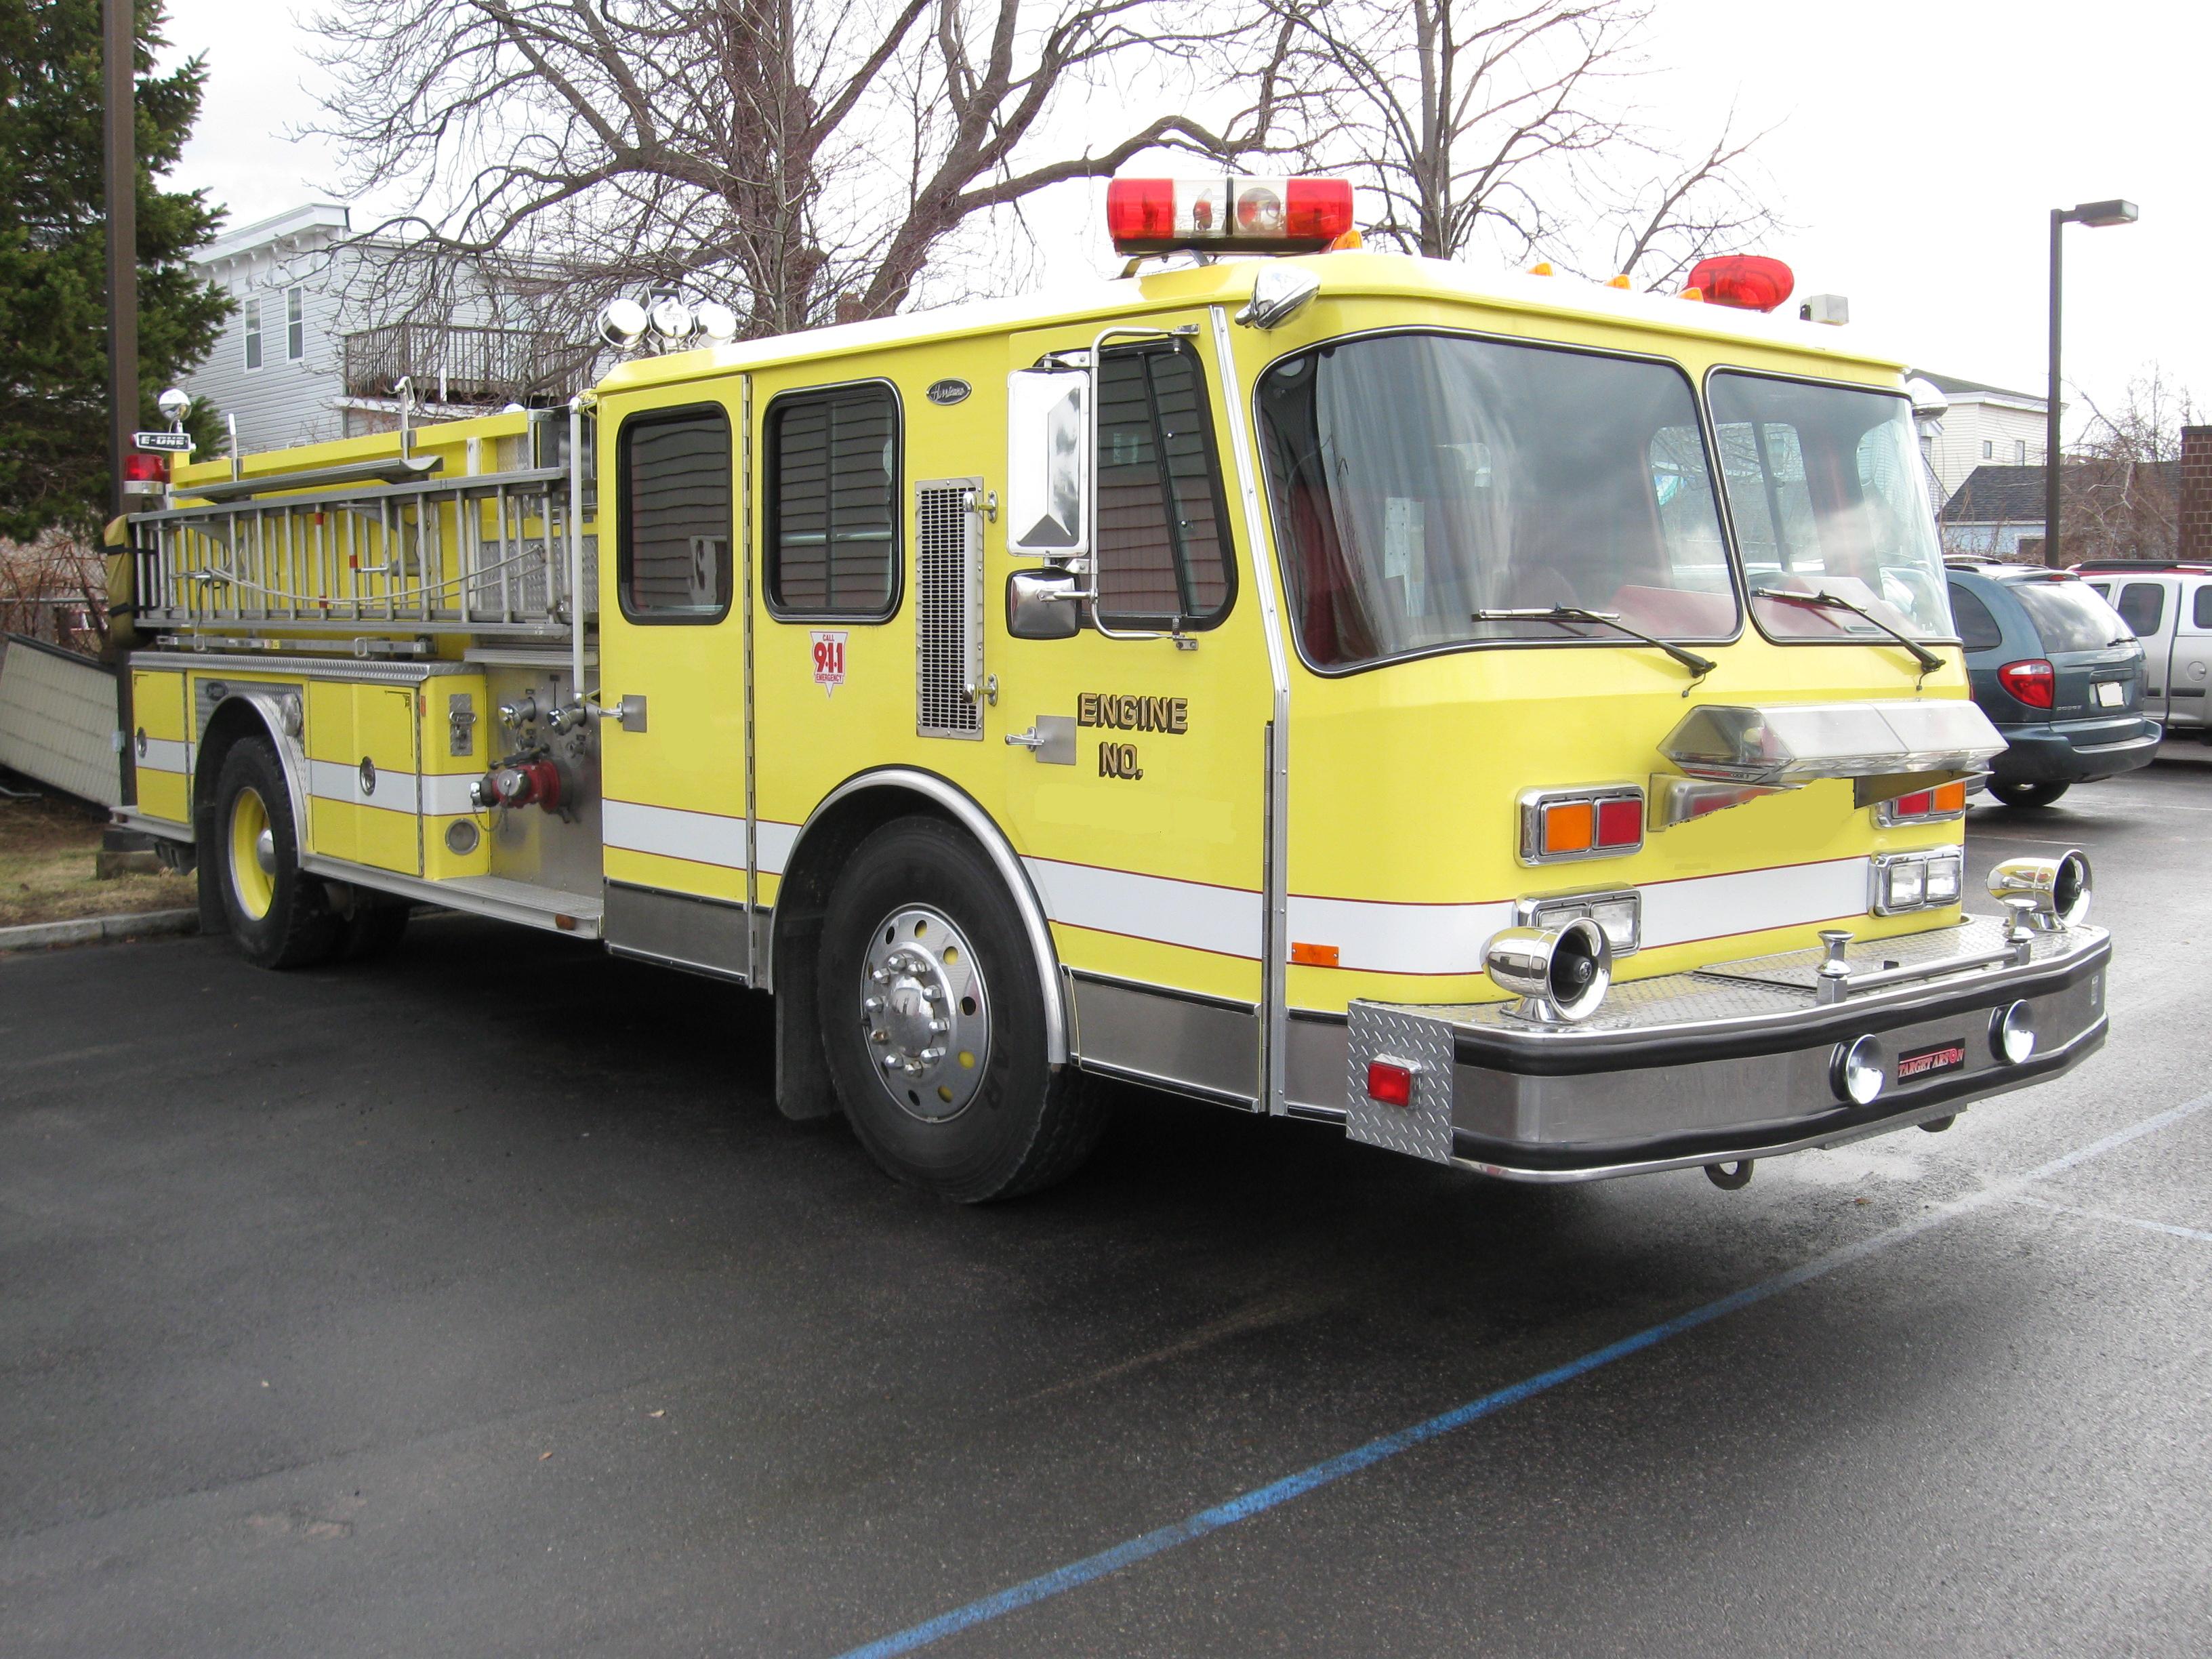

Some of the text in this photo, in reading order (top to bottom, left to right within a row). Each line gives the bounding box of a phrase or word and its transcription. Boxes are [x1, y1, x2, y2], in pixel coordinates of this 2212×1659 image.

[141, 436, 184, 445] E-ONE
[816, 673, 842, 682] EMERGENCY
[1078, 692, 1188, 735] ENGINE
[1099, 741, 1144, 780] NO.
[1898, 1048, 1964, 1078] TARGET ARSON
